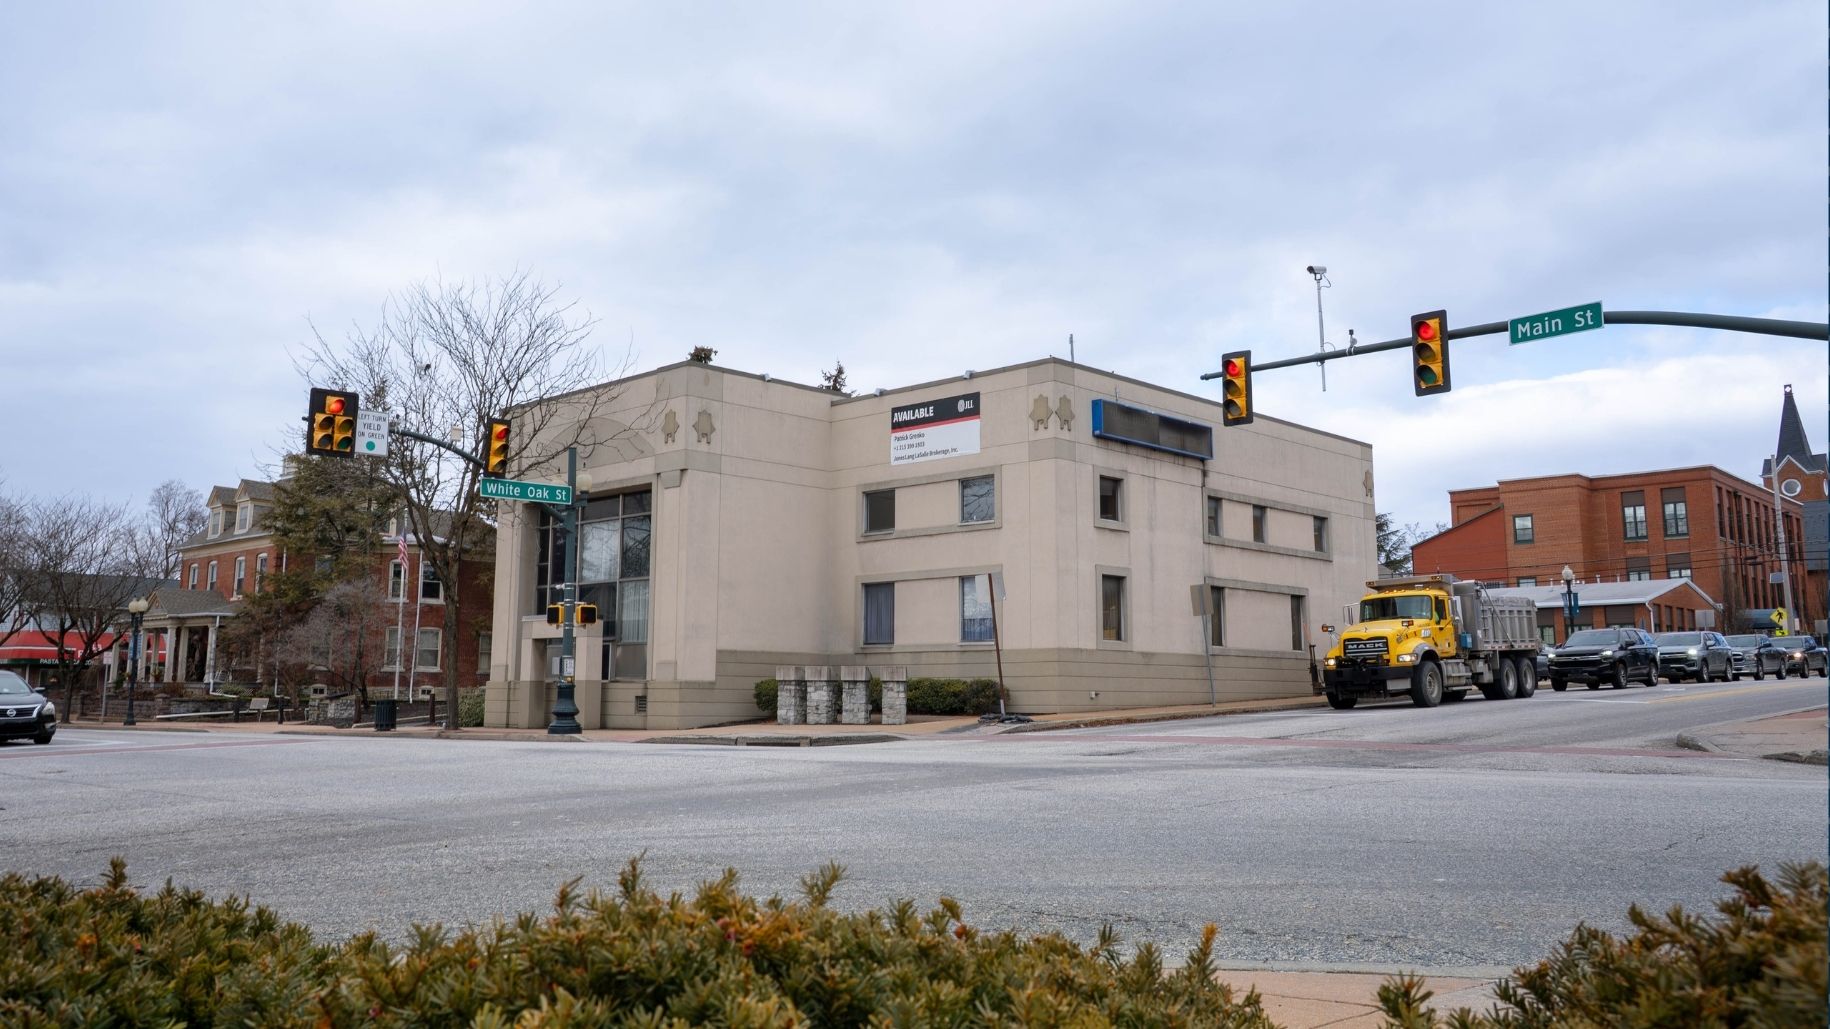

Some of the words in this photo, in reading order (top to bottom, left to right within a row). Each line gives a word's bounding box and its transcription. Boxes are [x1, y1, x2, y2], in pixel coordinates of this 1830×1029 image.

[1517, 317, 1562, 338] Main
[1574, 310, 1593, 328] St
[893, 406, 934, 423] AVAILABLE
[363, 422, 381, 431] YIELD
[368, 432, 385, 440] GREEN
[904, 452, 915, 460] Lang
[486, 483, 520, 496] White
[527, 486, 549, 499] Oak
[555, 489, 567, 501] St
